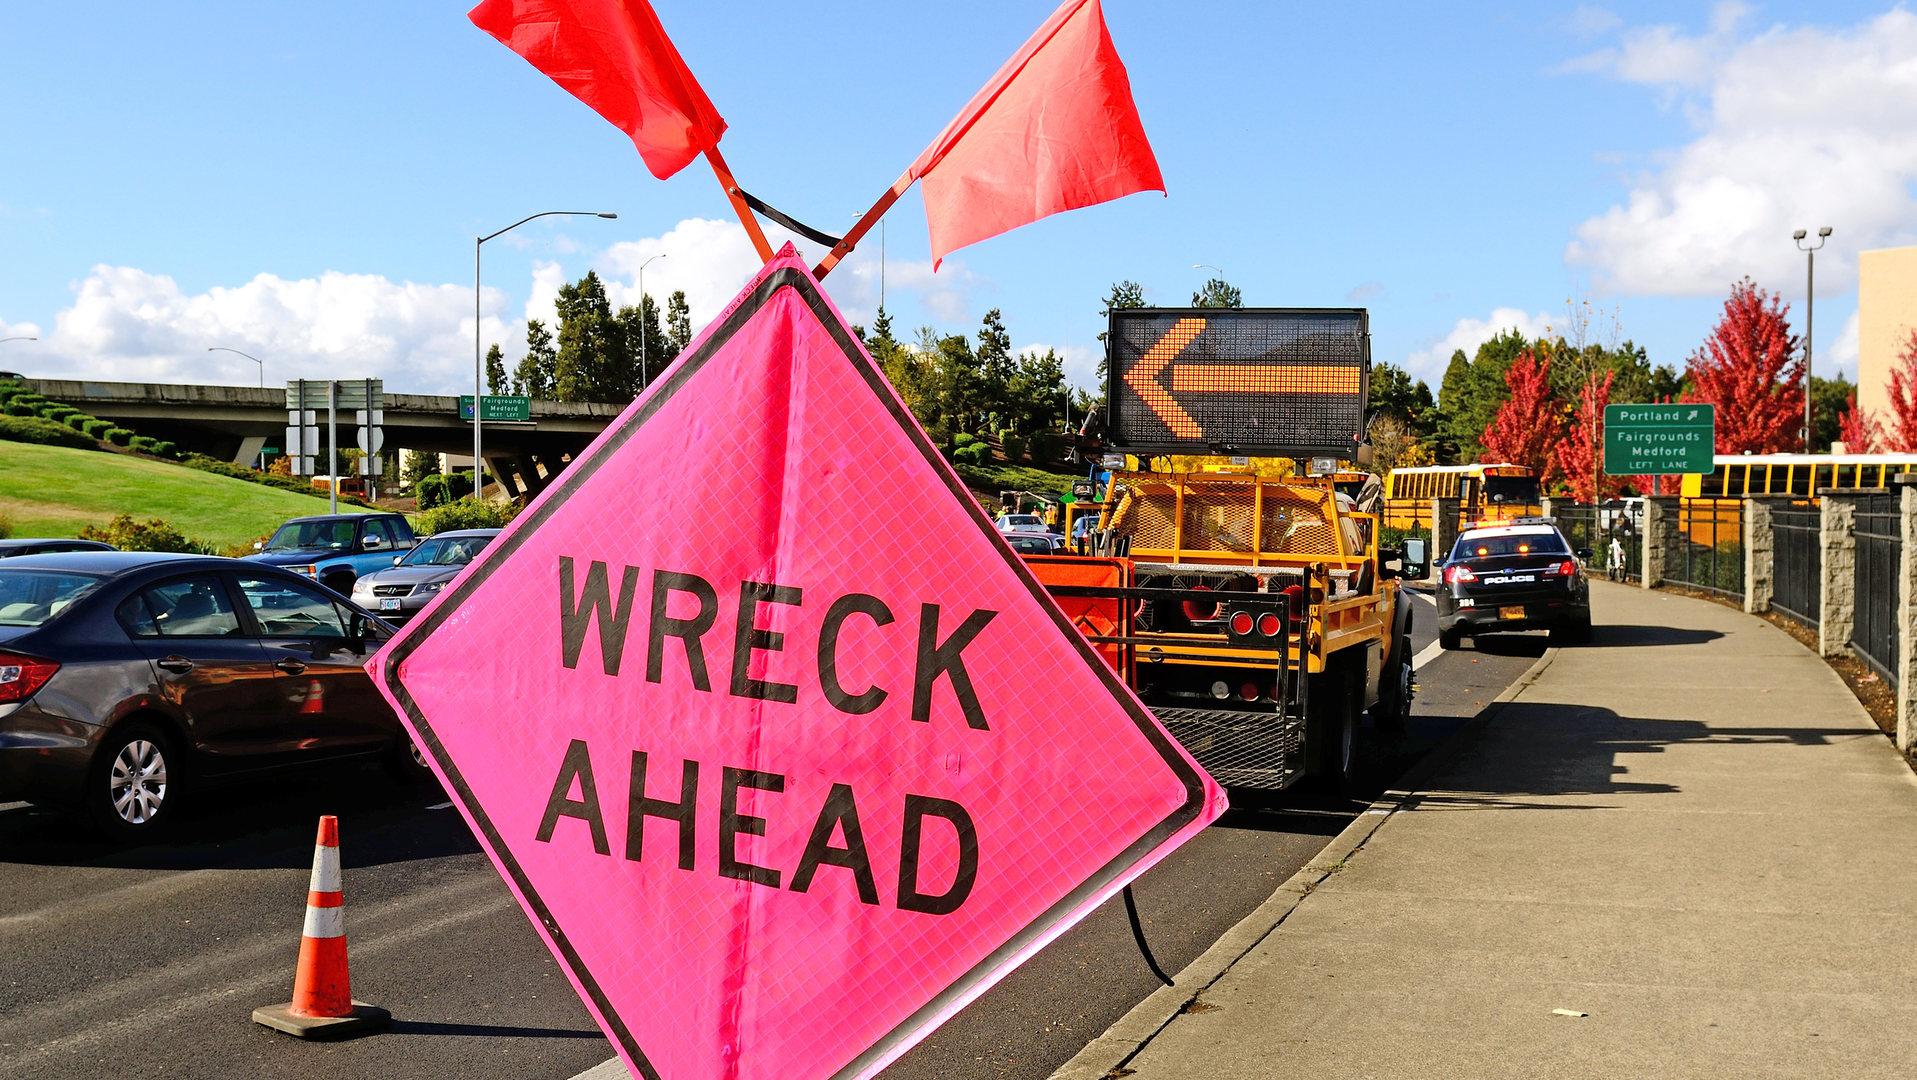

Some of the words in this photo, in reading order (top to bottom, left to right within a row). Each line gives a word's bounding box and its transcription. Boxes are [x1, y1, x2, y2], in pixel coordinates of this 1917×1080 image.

[741, 276, 763, 299] WRECK
[721, 297, 742, 320] AHEAD
[482, 397, 525, 405] Fairgrounds
[1620, 411, 1679, 421] Portland
[1618, 431, 1700, 444] Fairgrounds
[1632, 446, 1686, 456] Medford
[1629, 461, 1654, 469] LEFT
[1662, 461, 1689, 469] LANE
[1484, 575, 1535, 585] POLICE
[559, 555, 1000, 731] WRECK
[534, 738, 979, 916] AHEAD
